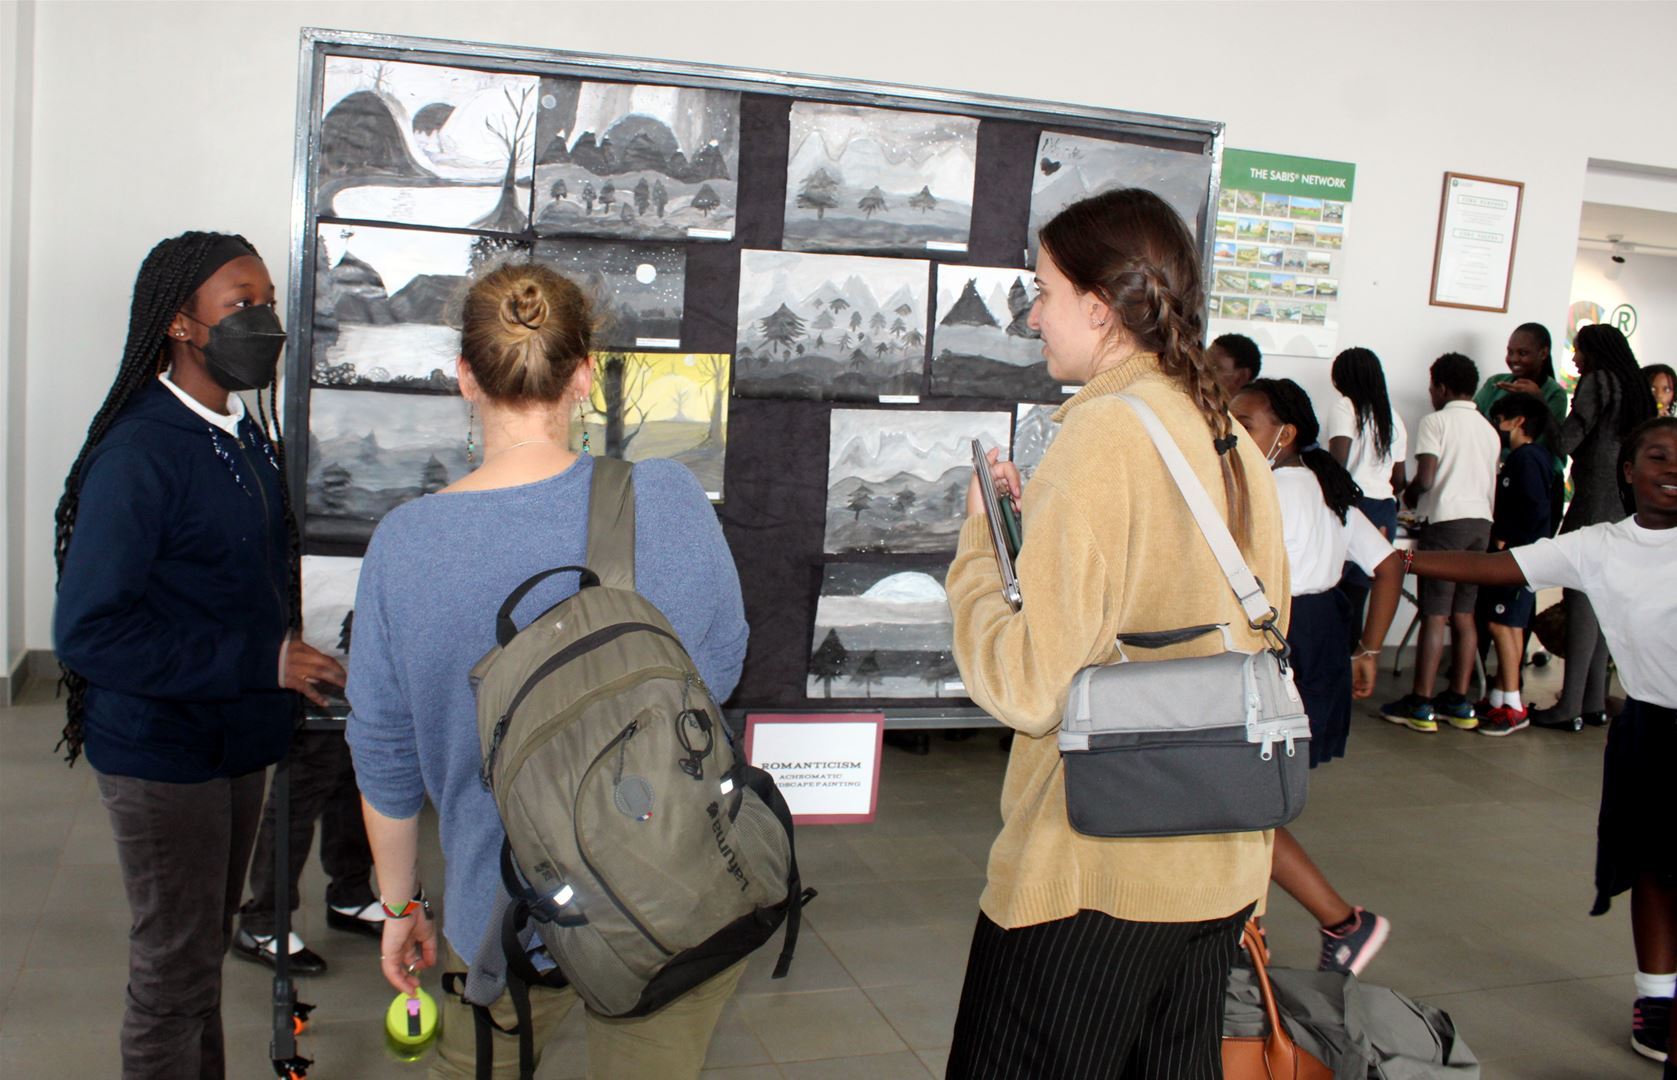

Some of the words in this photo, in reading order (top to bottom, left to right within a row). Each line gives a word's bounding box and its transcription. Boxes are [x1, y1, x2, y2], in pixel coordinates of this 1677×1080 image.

[1250, 167, 1268, 180] THE
[1301, 174, 1346, 189] NETWORK
[761, 761, 862, 770] ROMANTICISM
[779, 773, 843, 781] ACHROMATIC
[815, 780, 862, 788] PAINTING
[712, 820, 750, 892] Lafuma
